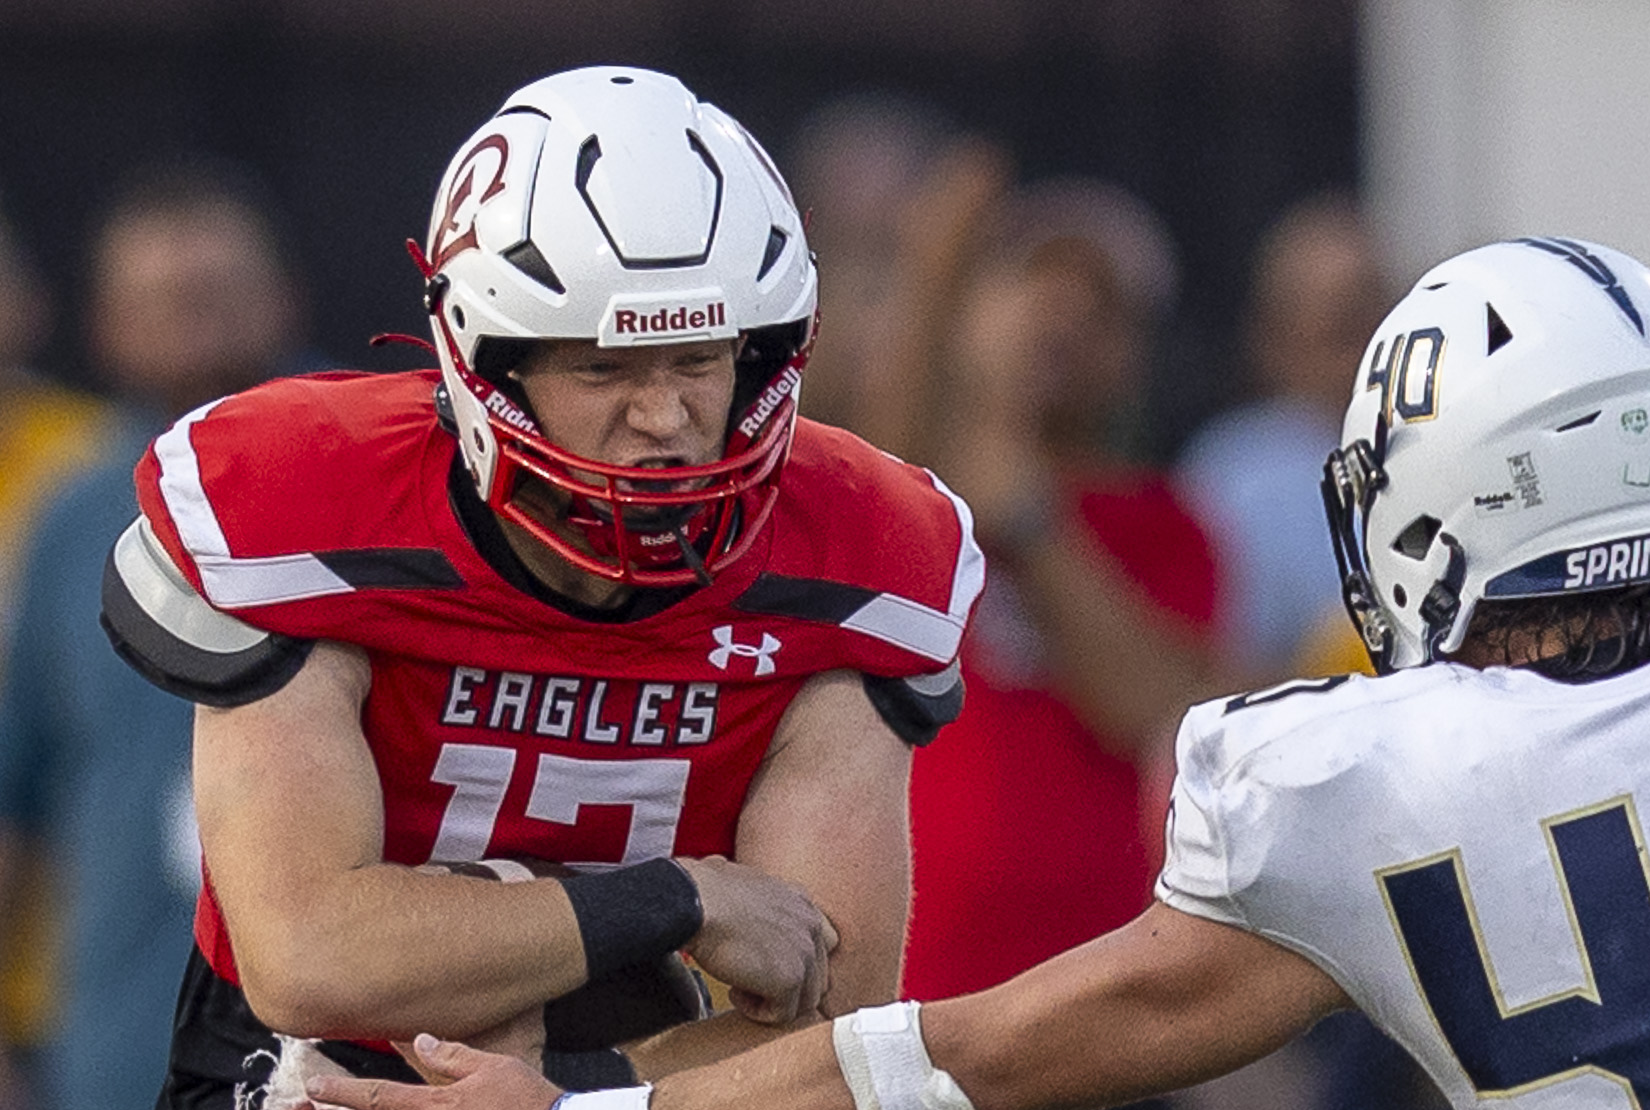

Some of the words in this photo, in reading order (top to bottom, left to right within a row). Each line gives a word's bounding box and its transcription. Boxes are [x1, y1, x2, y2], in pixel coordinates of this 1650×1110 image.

[615, 303, 726, 333] Riddell
[739, 366, 801, 437] Riddell
[1366, 327, 1449, 428] 40
[485, 391, 540, 436] Ridd
[440, 664, 718, 746] EAGLES
